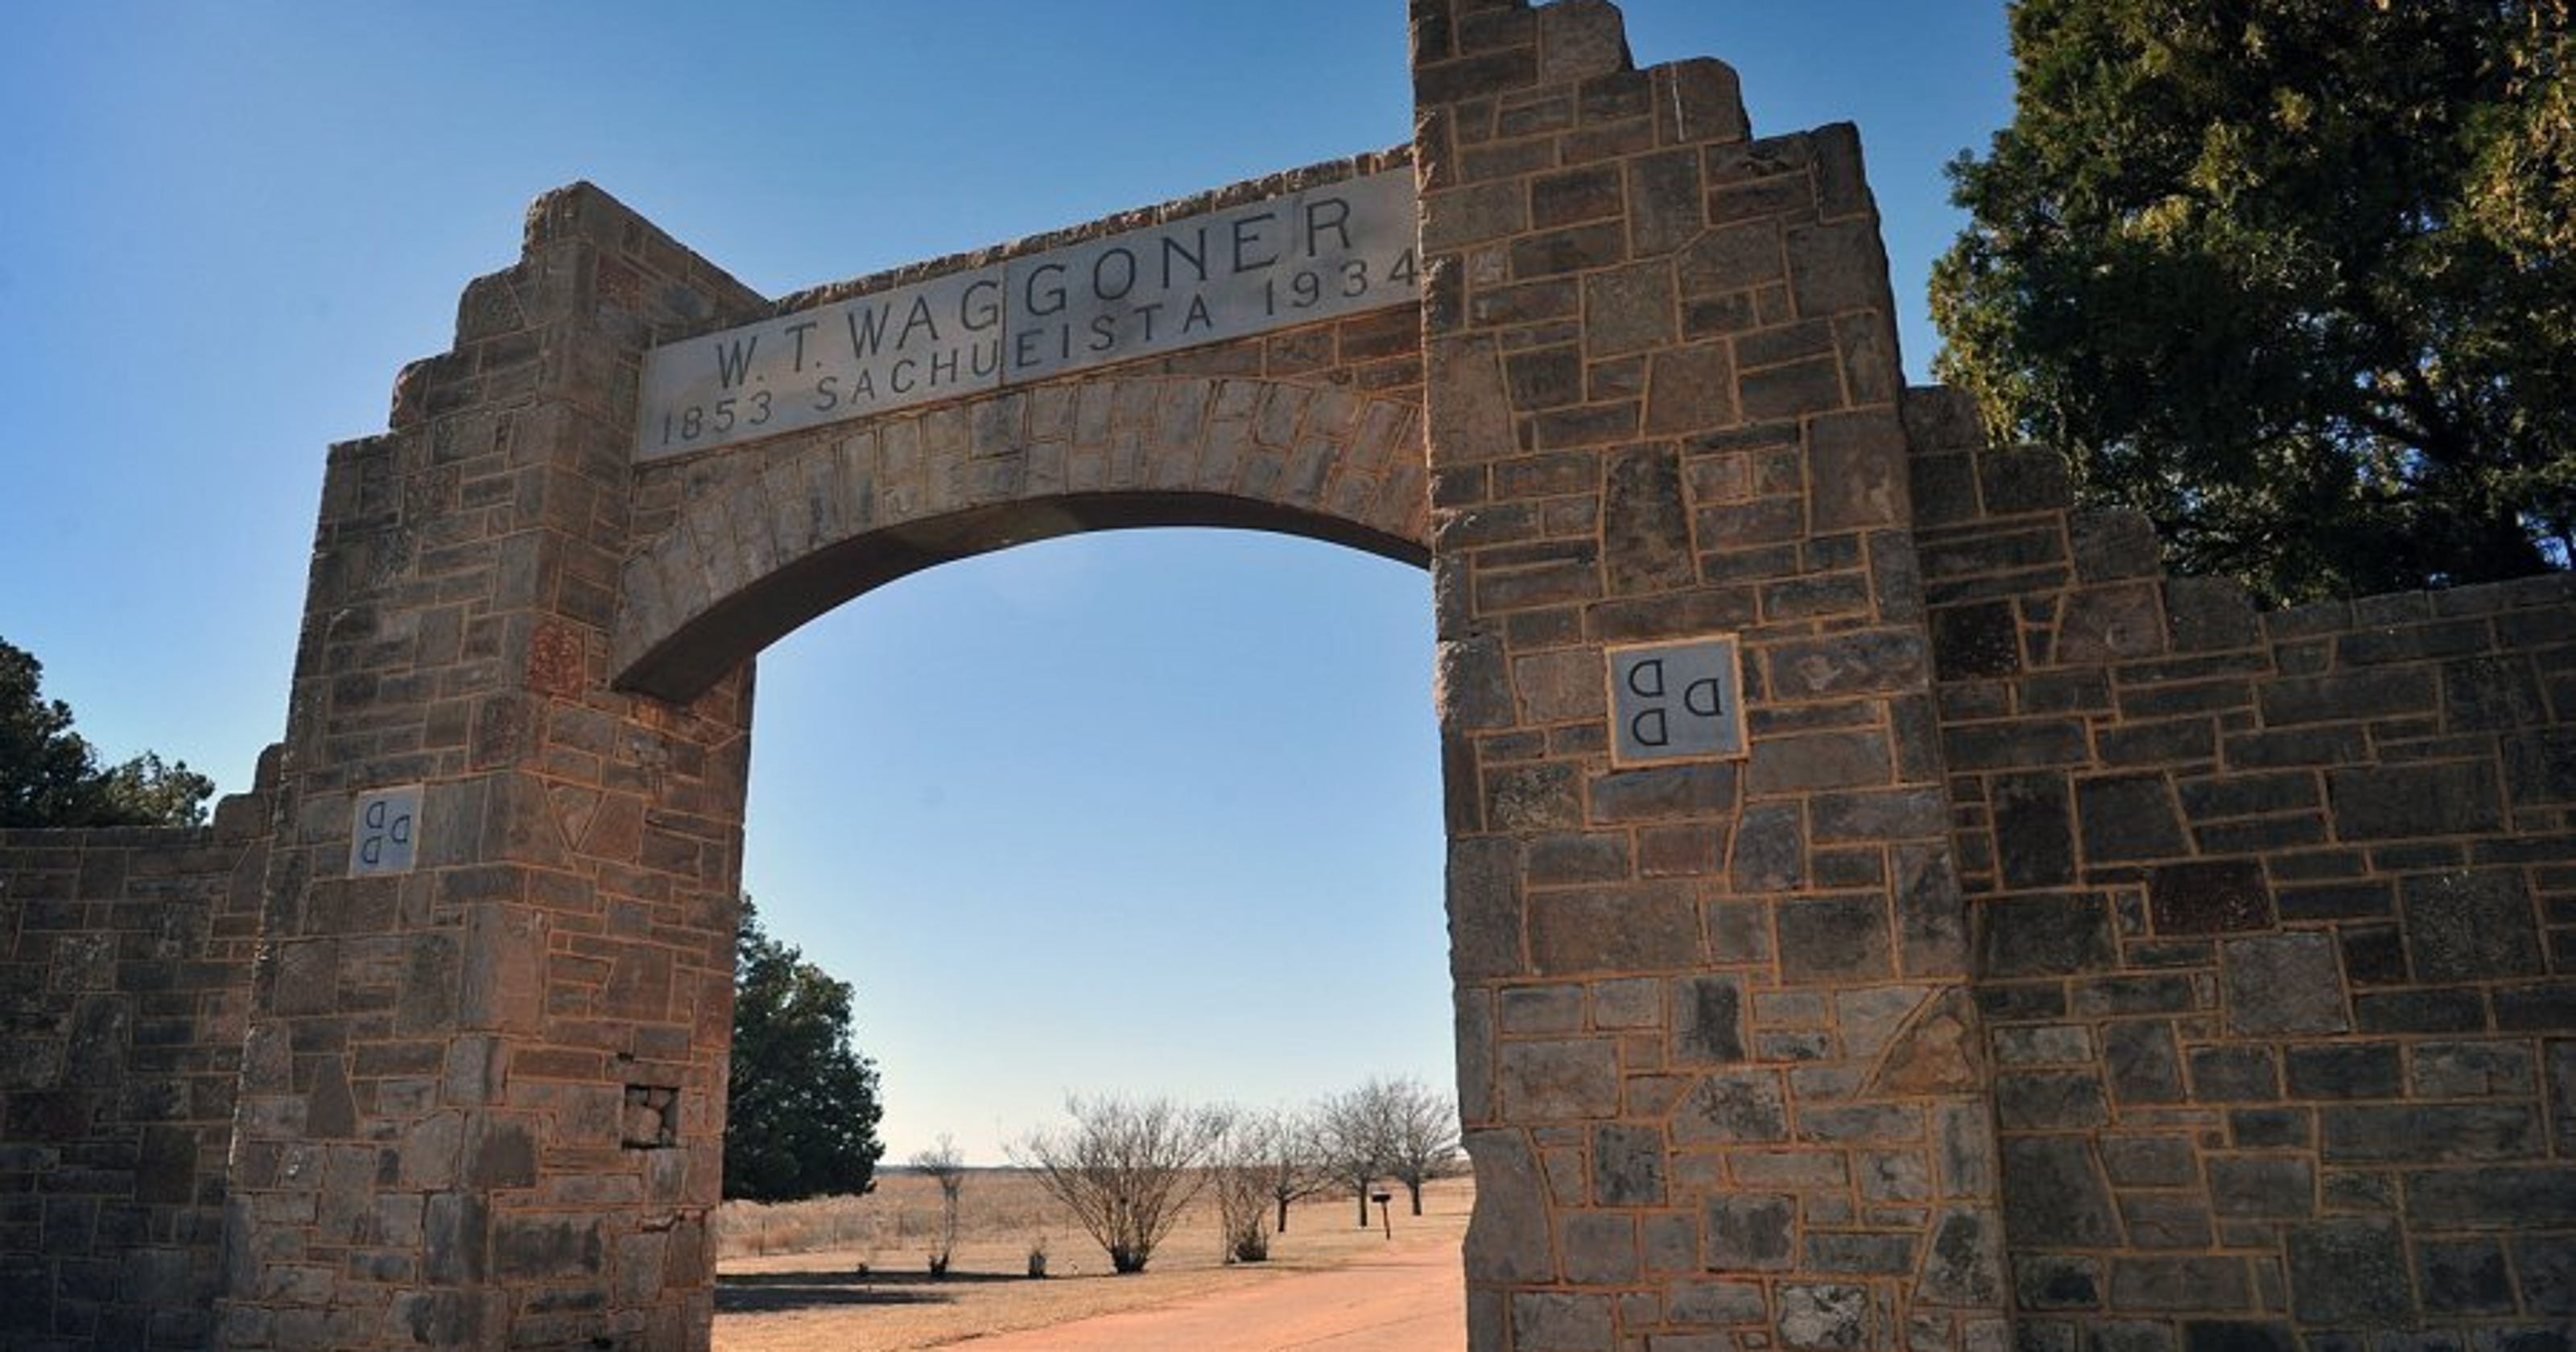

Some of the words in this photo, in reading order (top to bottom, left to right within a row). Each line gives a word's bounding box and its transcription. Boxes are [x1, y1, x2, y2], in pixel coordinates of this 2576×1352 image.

[663, 390, 772, 445] 1853
[815, 293, 1213, 411] SACHUEISTA
[1265, 247, 1420, 316] 1934
[848, 196, 1352, 359] WAGGONER
